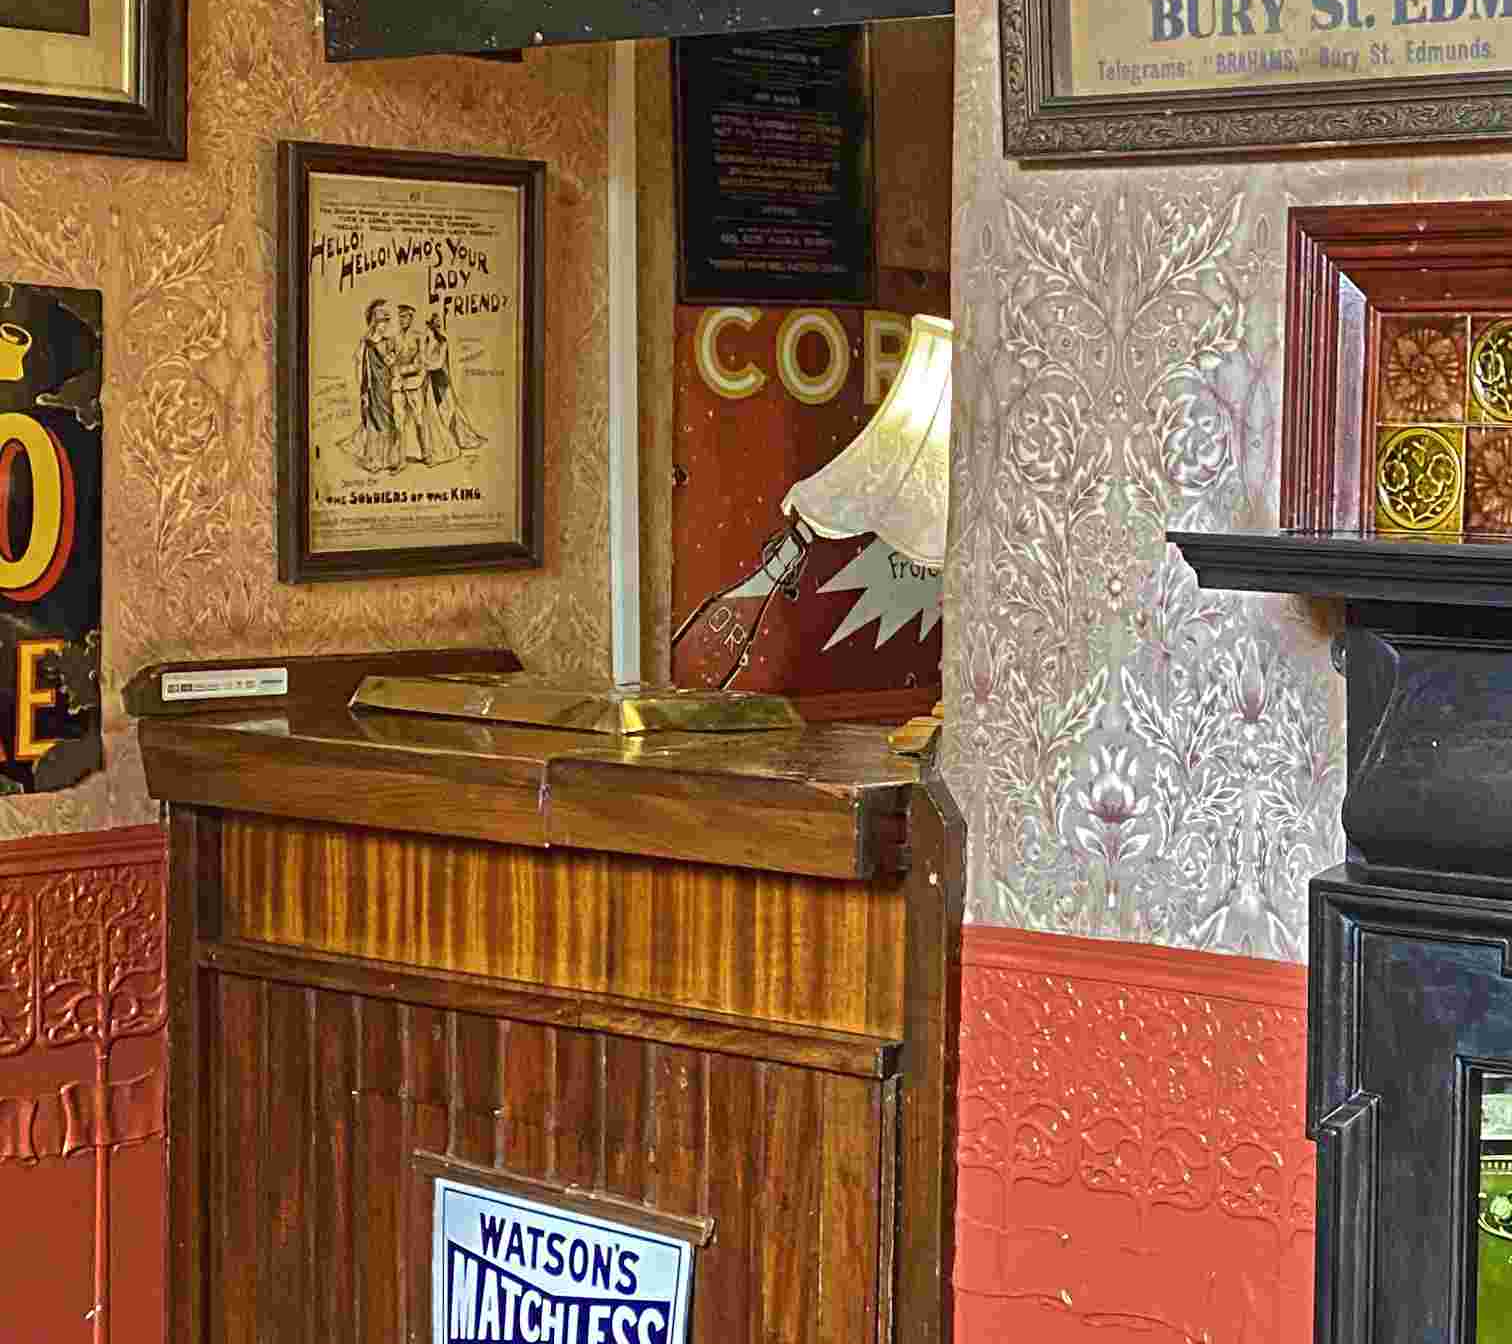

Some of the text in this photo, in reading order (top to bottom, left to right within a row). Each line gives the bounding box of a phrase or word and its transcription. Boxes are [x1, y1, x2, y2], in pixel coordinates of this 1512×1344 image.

[1319, 47, 1361, 73] Bury
[1370, 43, 1394, 66] St.
[310, 229, 364, 275] HELLO!
[339, 236, 489, 293] HELLO! WHO'S YOUR
[428, 265, 471, 304] LADY
[443, 293, 512, 335] FRIEND?
[450, 487, 481, 501] KING
[479, 1212, 640, 1295] WATSON'S
